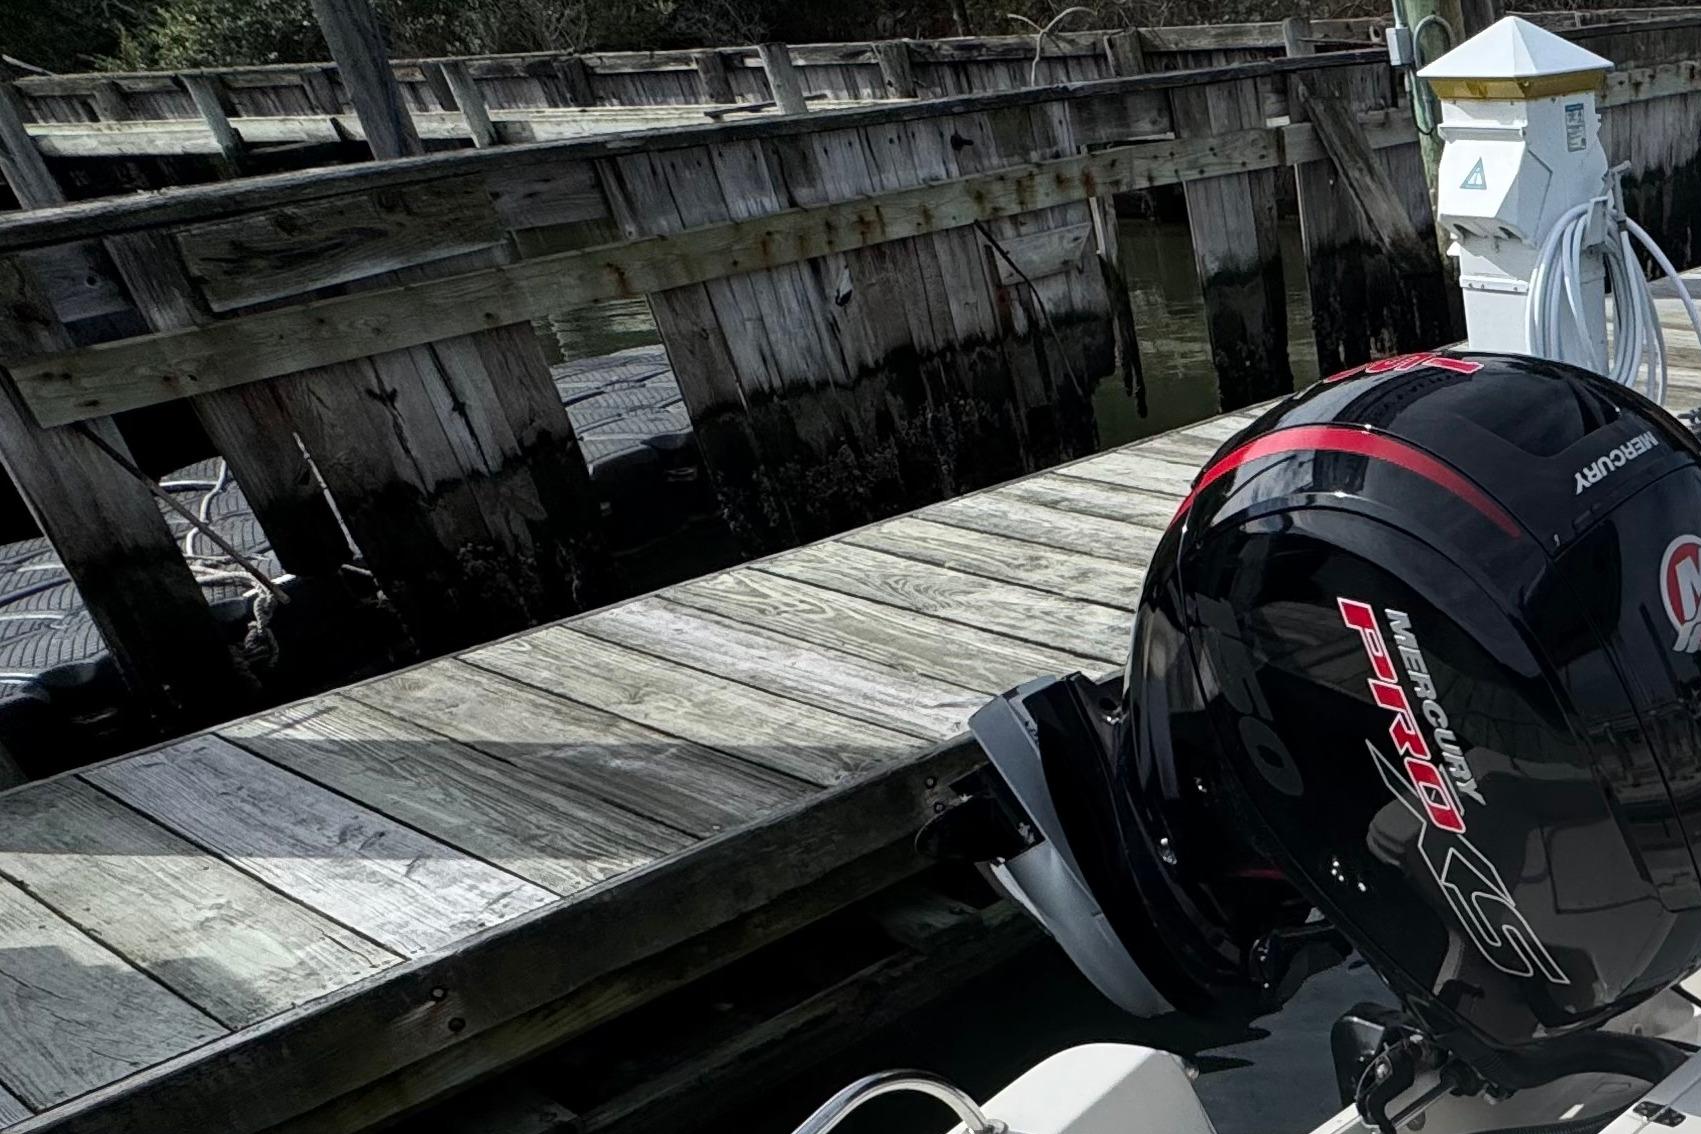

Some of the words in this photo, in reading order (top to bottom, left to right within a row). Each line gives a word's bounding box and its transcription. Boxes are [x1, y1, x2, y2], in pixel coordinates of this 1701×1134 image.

[1574, 430, 1659, 495] MERCURY
[1336, 597, 1467, 834] PRO
[1384, 608, 1487, 805] MERCURY
[1366, 738, 1571, 985] XS
